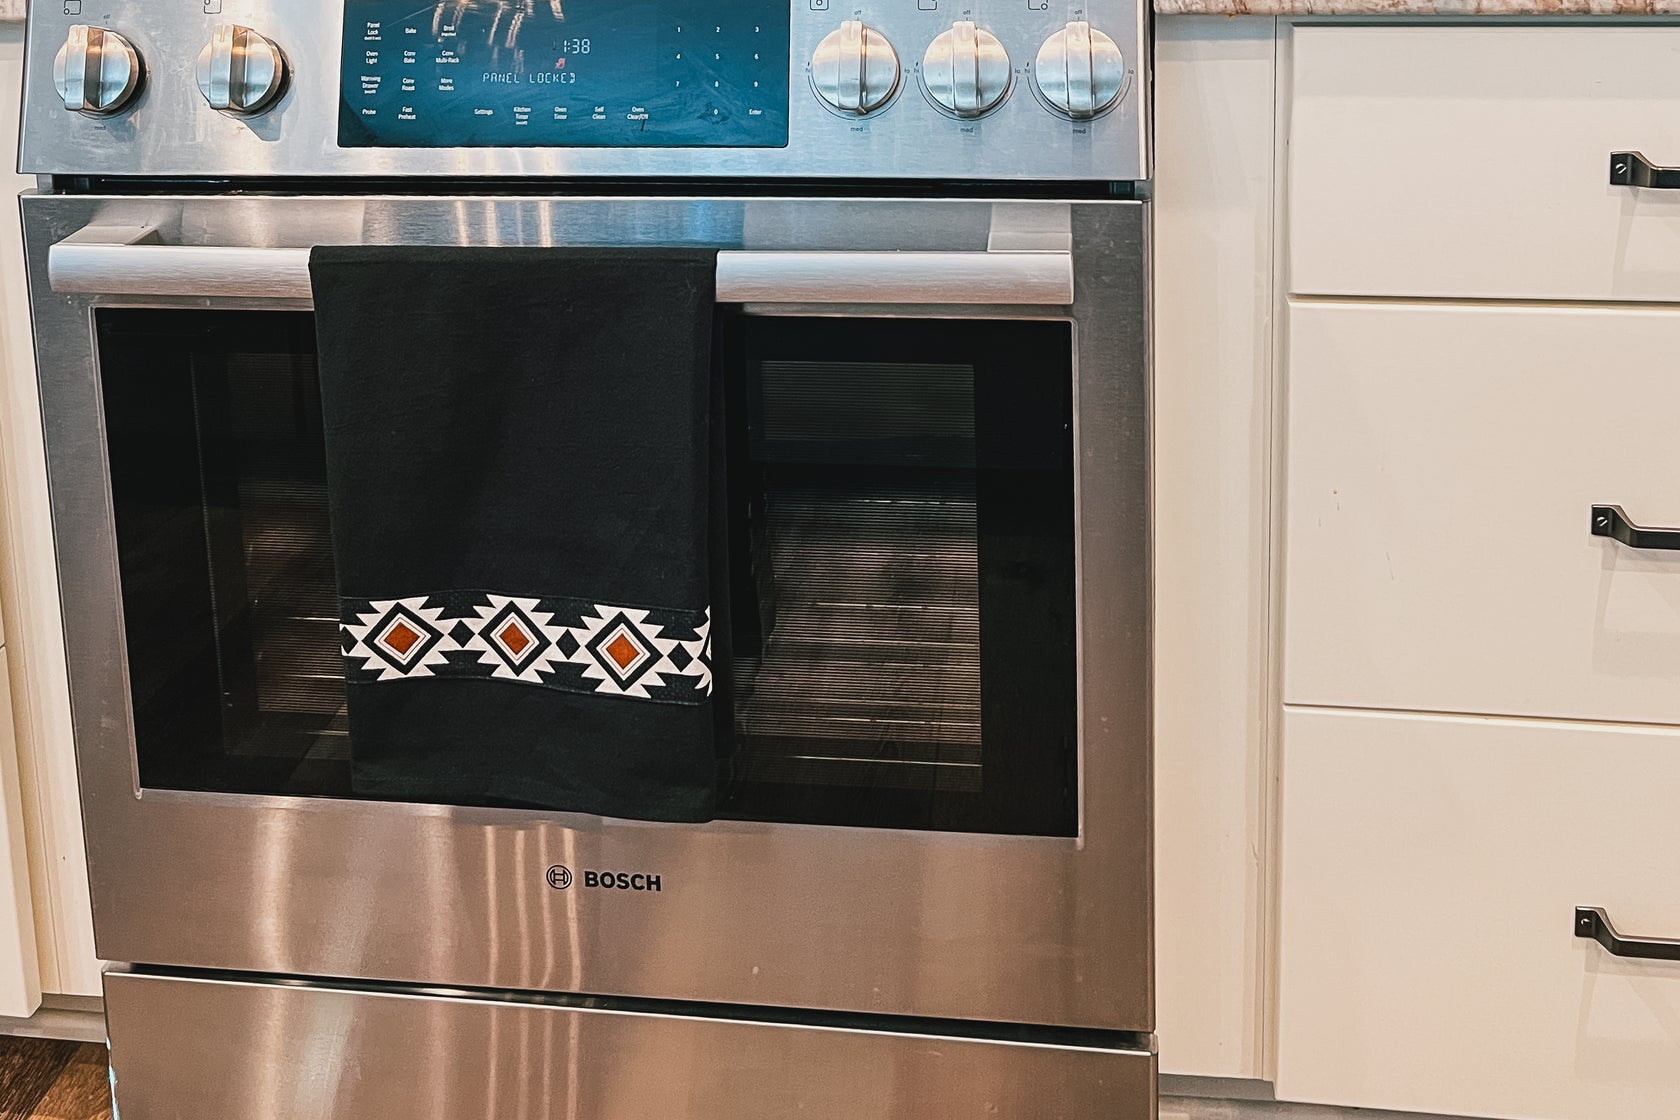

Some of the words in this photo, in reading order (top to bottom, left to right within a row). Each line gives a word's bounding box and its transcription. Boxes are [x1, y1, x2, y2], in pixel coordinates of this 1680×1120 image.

[563, 38, 590, 54] 1:38
[482, 73, 520, 84] PANEL
[529, 72, 576, 84] LOCKED
[584, 871, 662, 891] BOSCH
